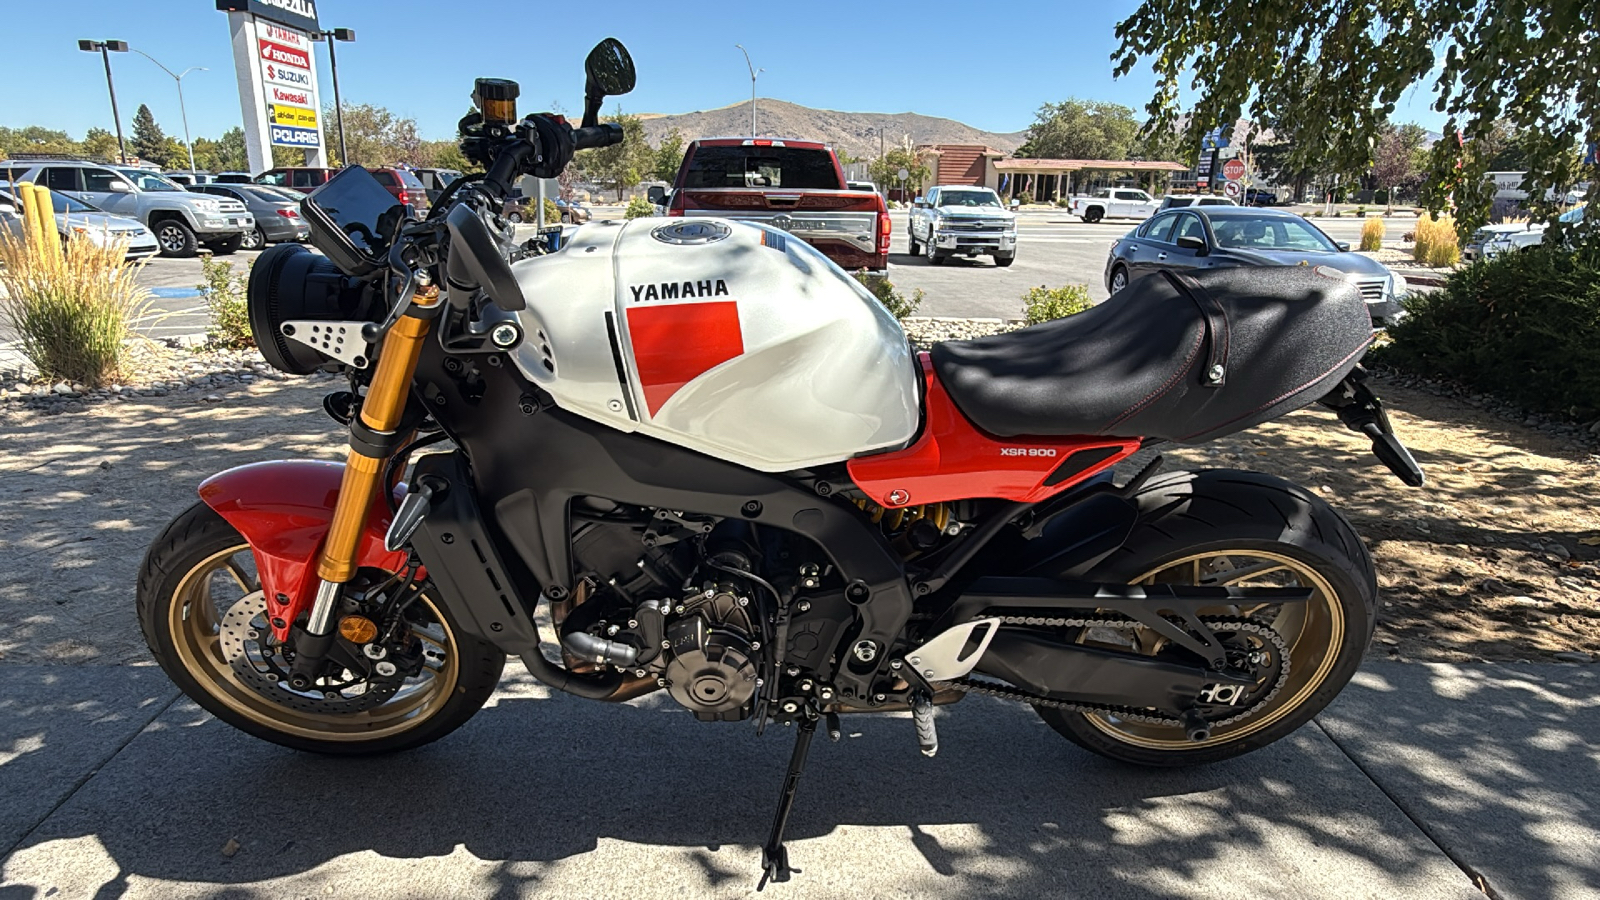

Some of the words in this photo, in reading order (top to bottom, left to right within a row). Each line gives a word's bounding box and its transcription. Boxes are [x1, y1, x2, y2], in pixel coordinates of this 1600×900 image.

[273, 25, 301, 46] YAMAHA
[272, 49, 308, 68] HONDA
[278, 69, 309, 85] SUZUKI
[273, 88, 308, 105] Kawasaki
[273, 128, 319, 144] POLARIS
[1224, 166, 1245, 174] STOP
[630, 279, 729, 302] YAMAHA
[1000, 447, 1027, 456] XSR
[1028, 448, 1057, 457] 900
